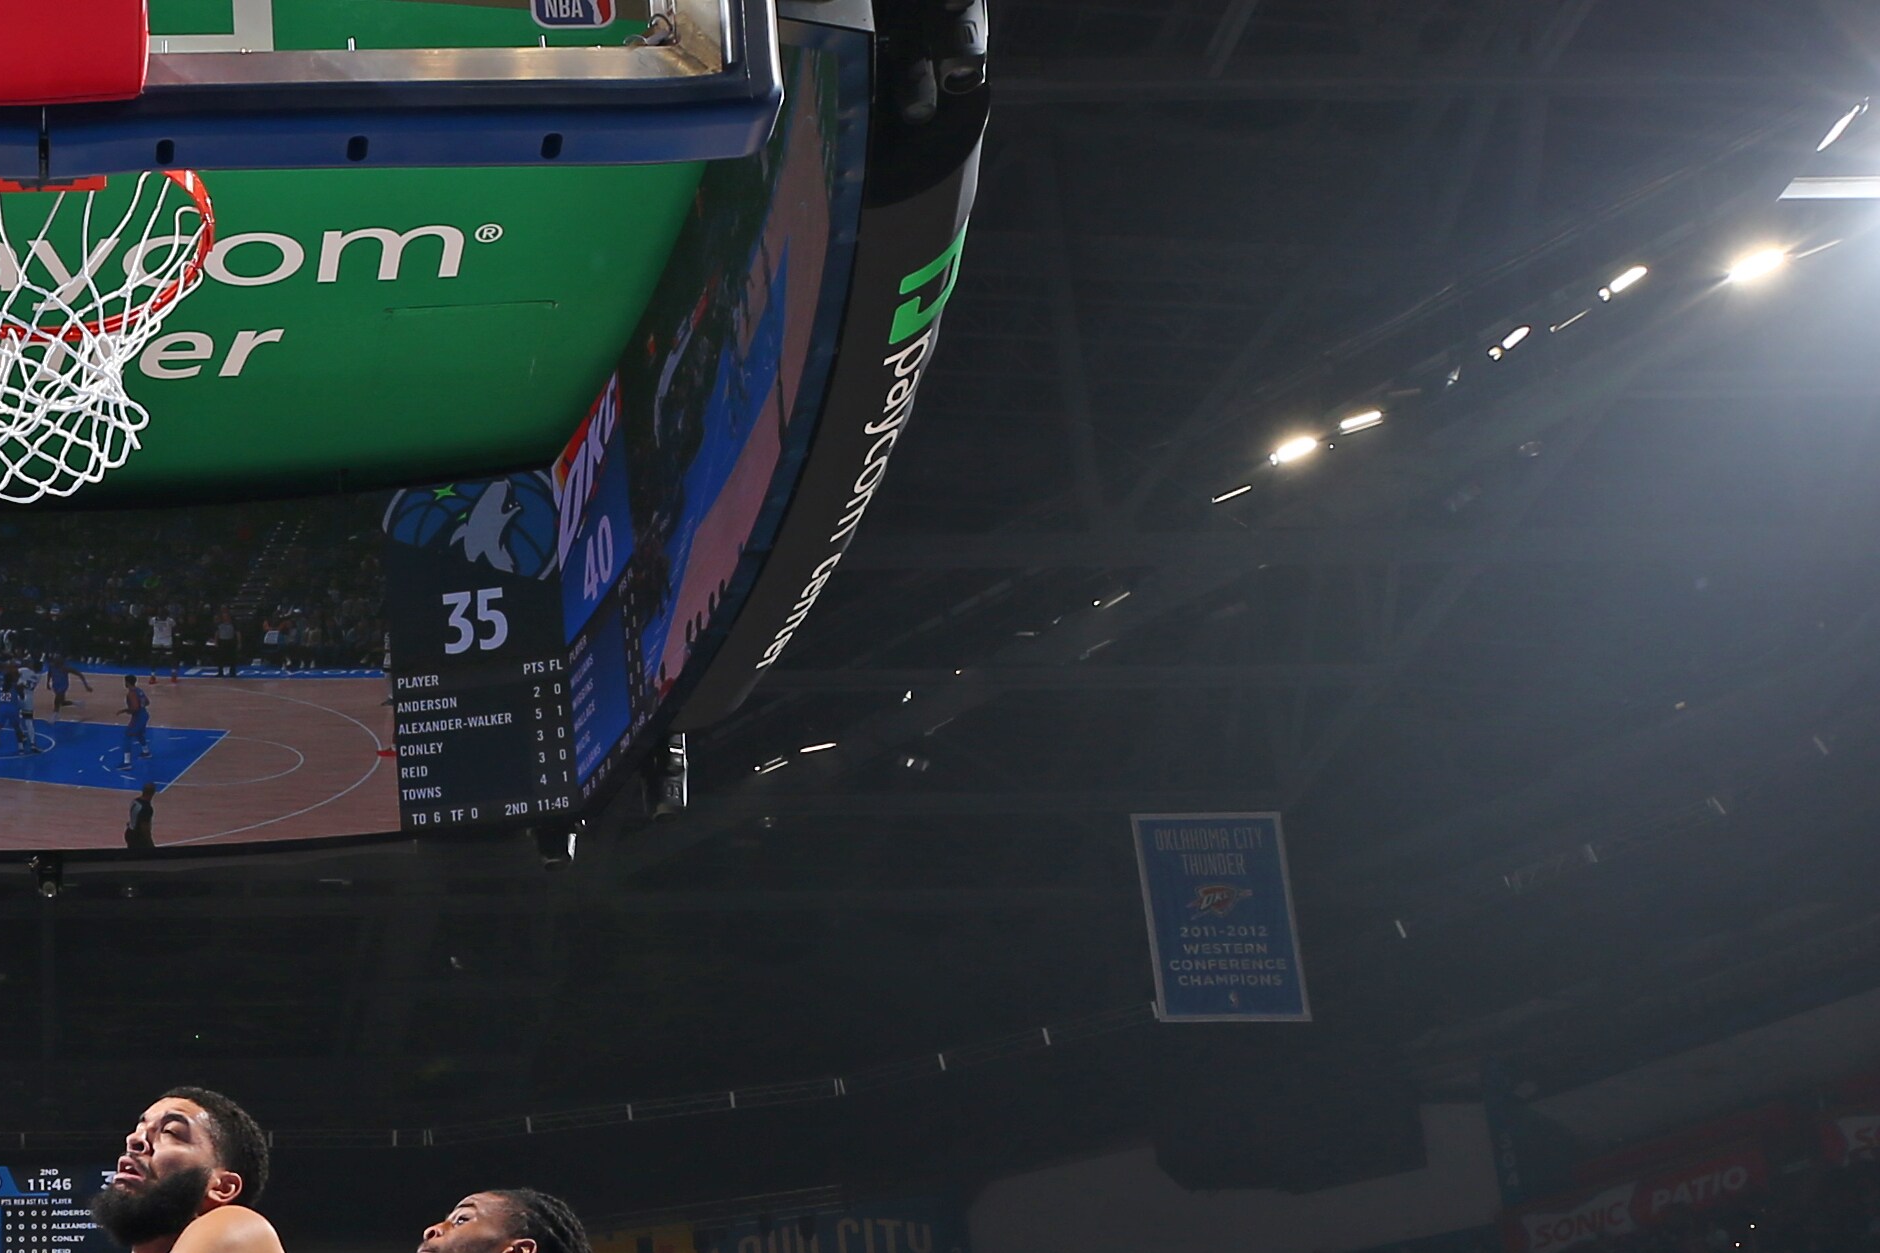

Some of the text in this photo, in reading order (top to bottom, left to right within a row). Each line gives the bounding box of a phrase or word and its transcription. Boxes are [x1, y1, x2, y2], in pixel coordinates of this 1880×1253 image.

[544, 0, 584, 18] NBA
[756, 328, 933, 669] paycom center
[583, 515, 614, 601] 40
[442, 587, 509, 655] 35
[397, 659, 563, 690] PLAYER PTS FL
[397, 683, 561, 713] ANDERSON 2 0
[398, 705, 563, 735] ALEXANDER-WALKER 5 1
[400, 727, 565, 757] CONLEY 3 0
[401, 749, 566, 779] REID 3 0
[402, 771, 568, 801] TOWNS 4 1
[412, 796, 570, 825] TO 6 TF 0 2ND 11:46
[1154, 827, 1264, 852] OKLAHOMA CITY
[1181, 853, 1247, 876] THUNDER
[1180, 925, 1269, 938] 2011-2012
[1183, 943, 1268, 955] WESTERN
[1170, 959, 1287, 972] CONFERENCE
[1178, 974, 1283, 987] CHAMPIONS
[28, 1178, 72, 1191] 11:46
[40, 1168, 59, 1176] 2ND
[1651, 1165, 1750, 1216] PATIO
[1535, 1200, 1626, 1249] SONIC
